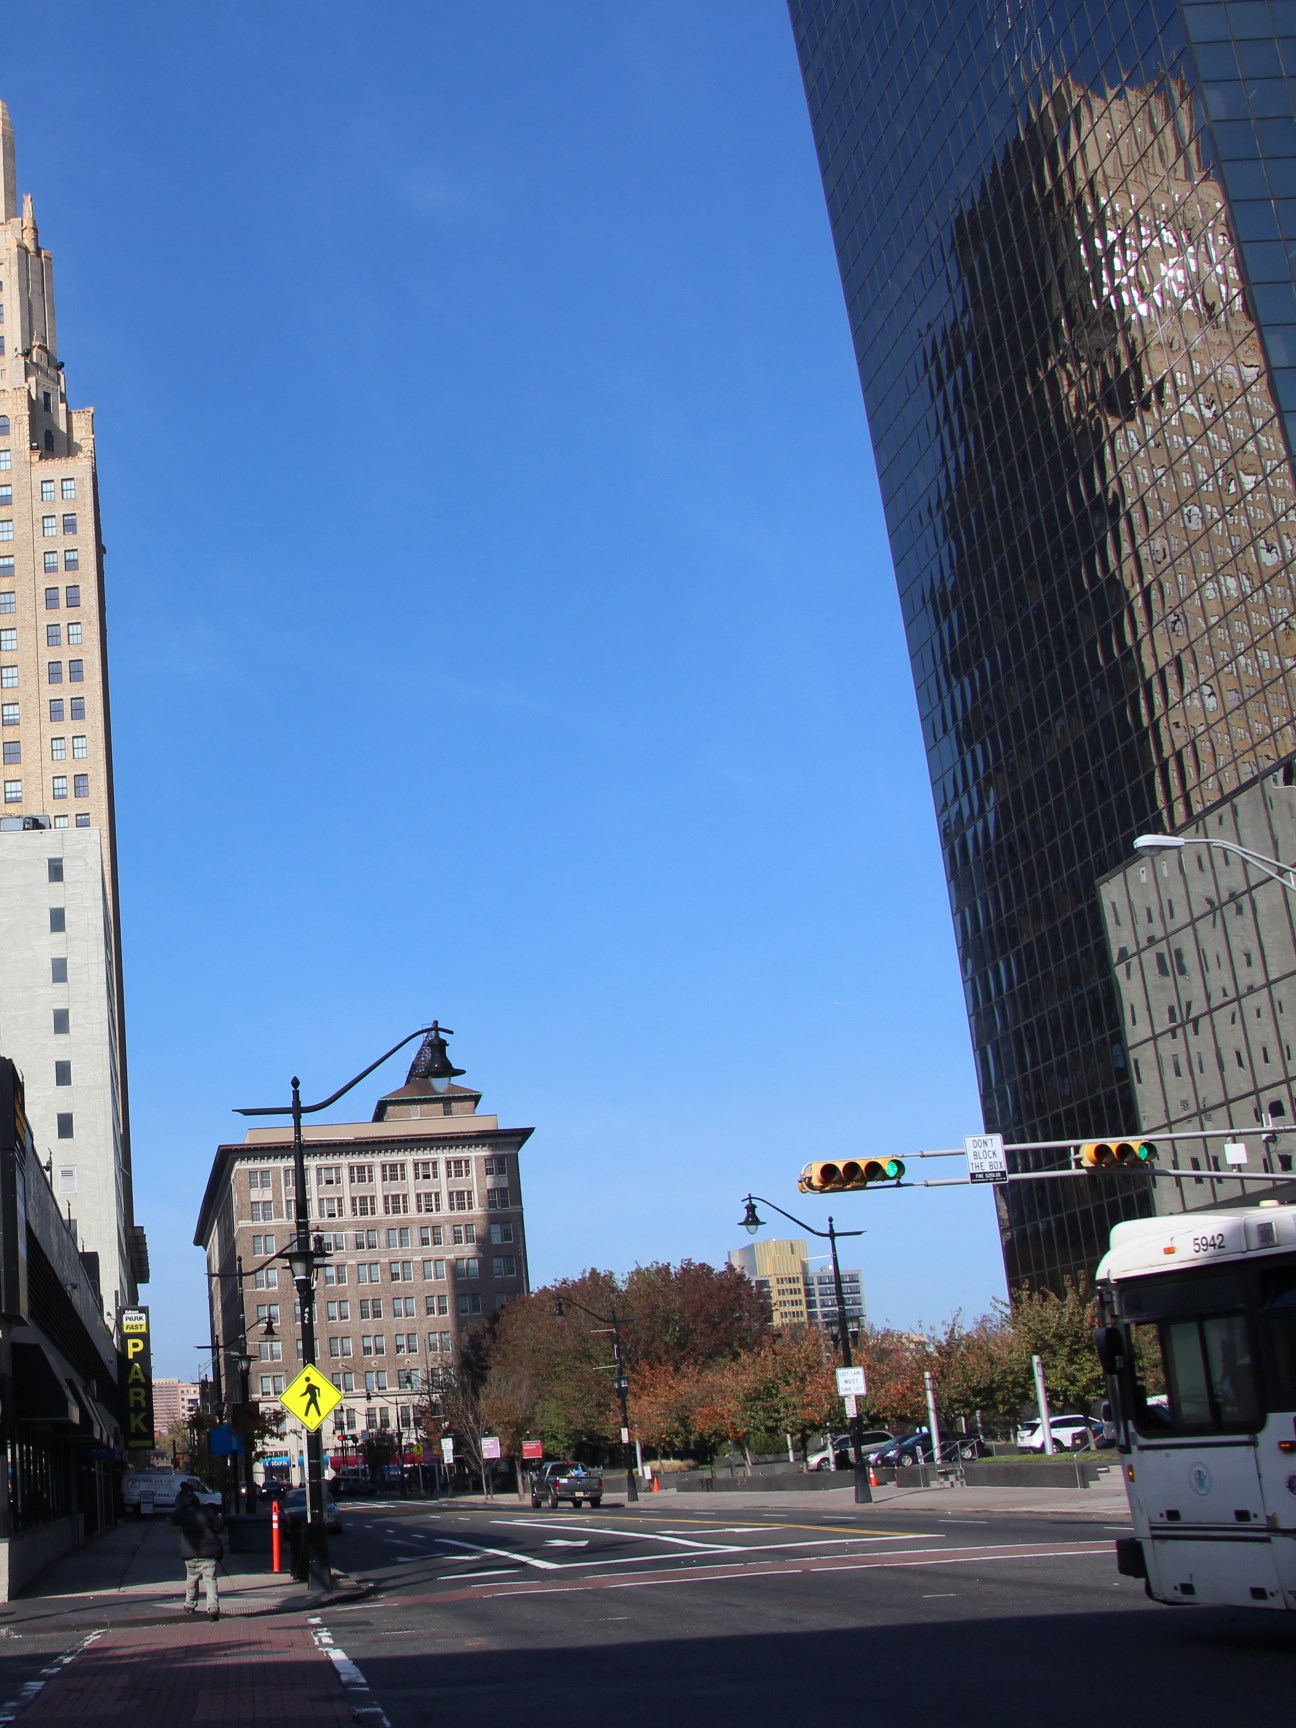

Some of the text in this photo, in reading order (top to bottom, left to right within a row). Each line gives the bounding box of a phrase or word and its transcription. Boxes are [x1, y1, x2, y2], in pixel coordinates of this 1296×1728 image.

[972, 1138, 994, 1149] DON'T
[973, 1149, 997, 1160] BLOCK
[970, 1160, 1003, 1171] THE BOX
[1193, 1233, 1226, 1253] 5942
[127, 1338, 148, 1433] PARK
